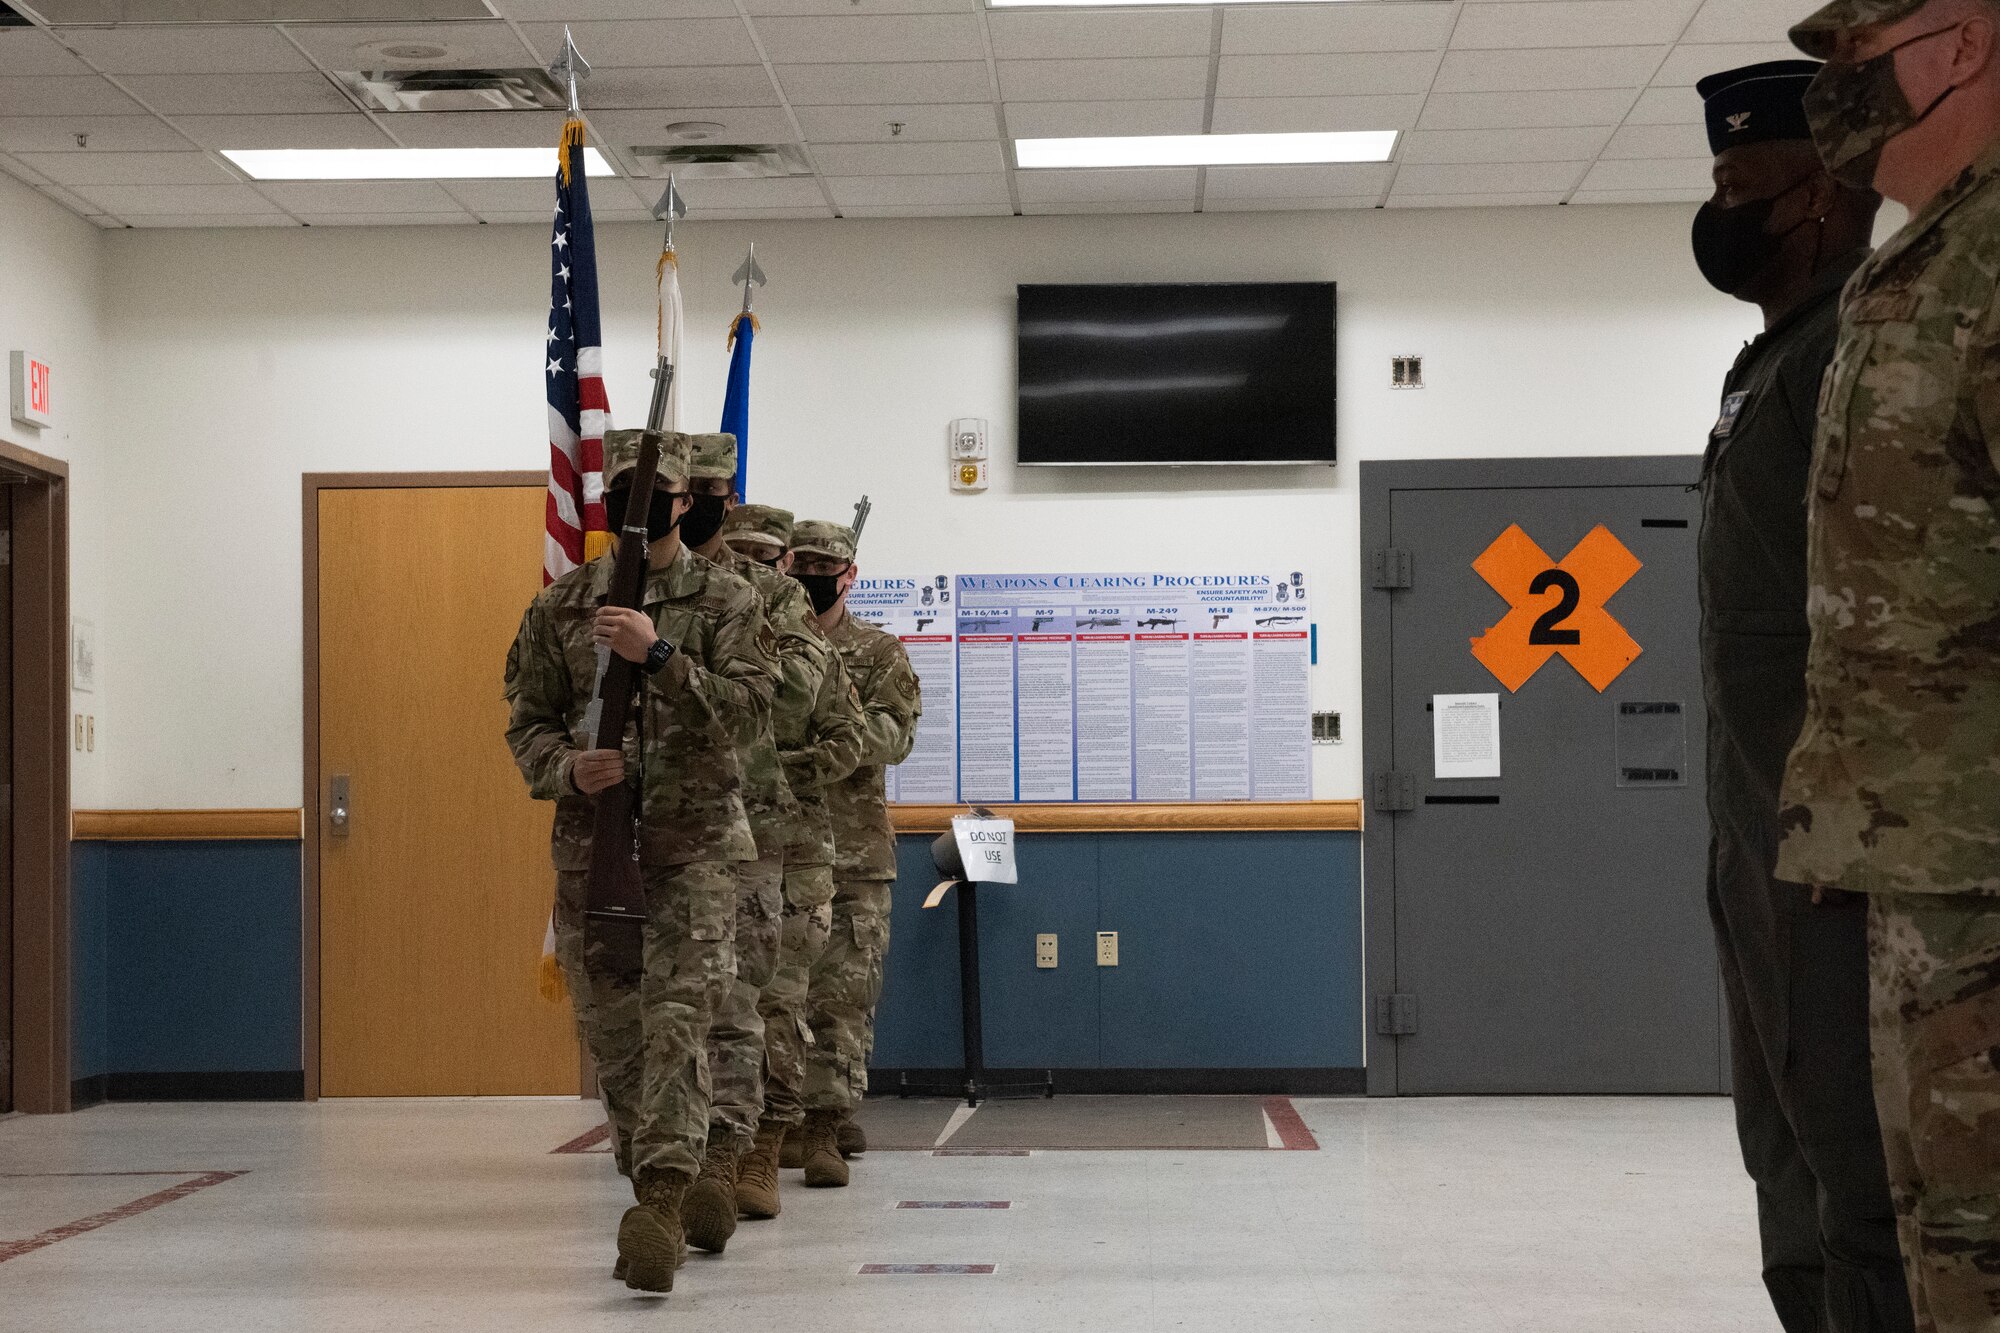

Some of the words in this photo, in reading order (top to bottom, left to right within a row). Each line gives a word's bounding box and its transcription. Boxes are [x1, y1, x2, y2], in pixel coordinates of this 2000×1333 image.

[31, 360, 49, 415] EXIT
[850, 579, 916, 590] EDURES
[960, 577, 1048, 588] WEAPONS
[1053, 575, 1146, 588] CLEARING
[1153, 574, 1270, 587] PROCEDURES
[1528, 568, 1580, 645] 2
[961, 609, 1009, 618] M-16/M-4
[970, 831, 986, 841] DO
[988, 831, 1007, 842] NOT
[985, 850, 1002, 861] USE
